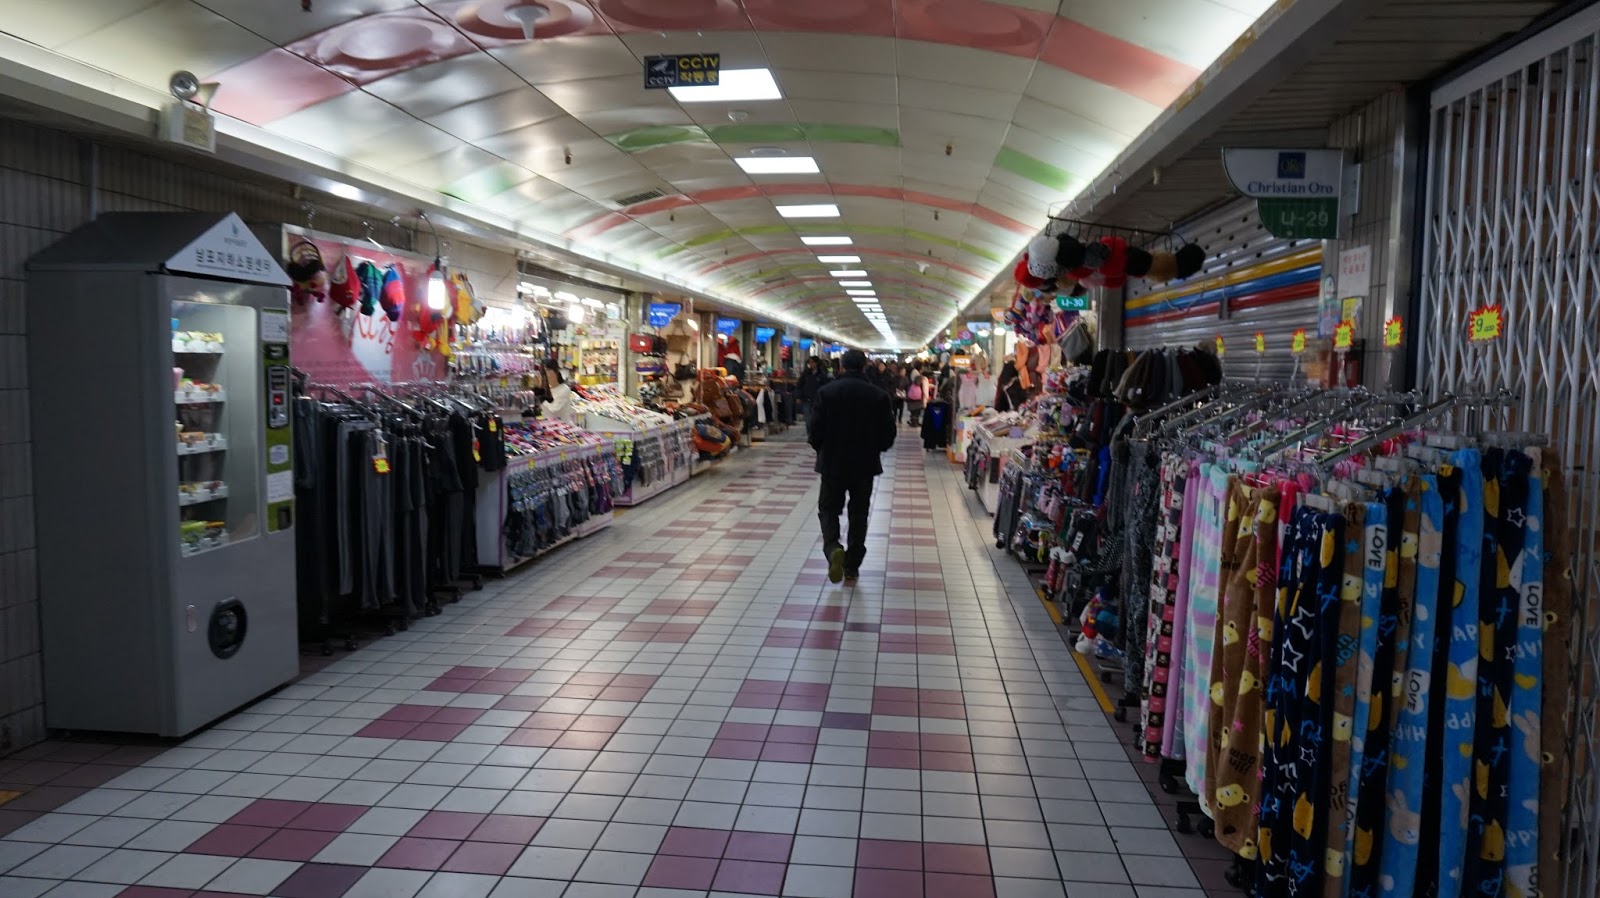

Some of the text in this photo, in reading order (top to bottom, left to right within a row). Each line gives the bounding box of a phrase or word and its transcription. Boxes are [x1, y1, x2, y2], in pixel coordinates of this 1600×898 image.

[679, 56, 719, 69] CCTV
[649, 76, 675, 85] CCTV
[680, 70, 717, 83] 작동중
[1248, 181, 1333, 194] Christian Oro
[1368, 527, 1385, 568] LOVE
[1526, 585, 1539, 626] LOVE
[1407, 671, 1422, 711] LOVE
